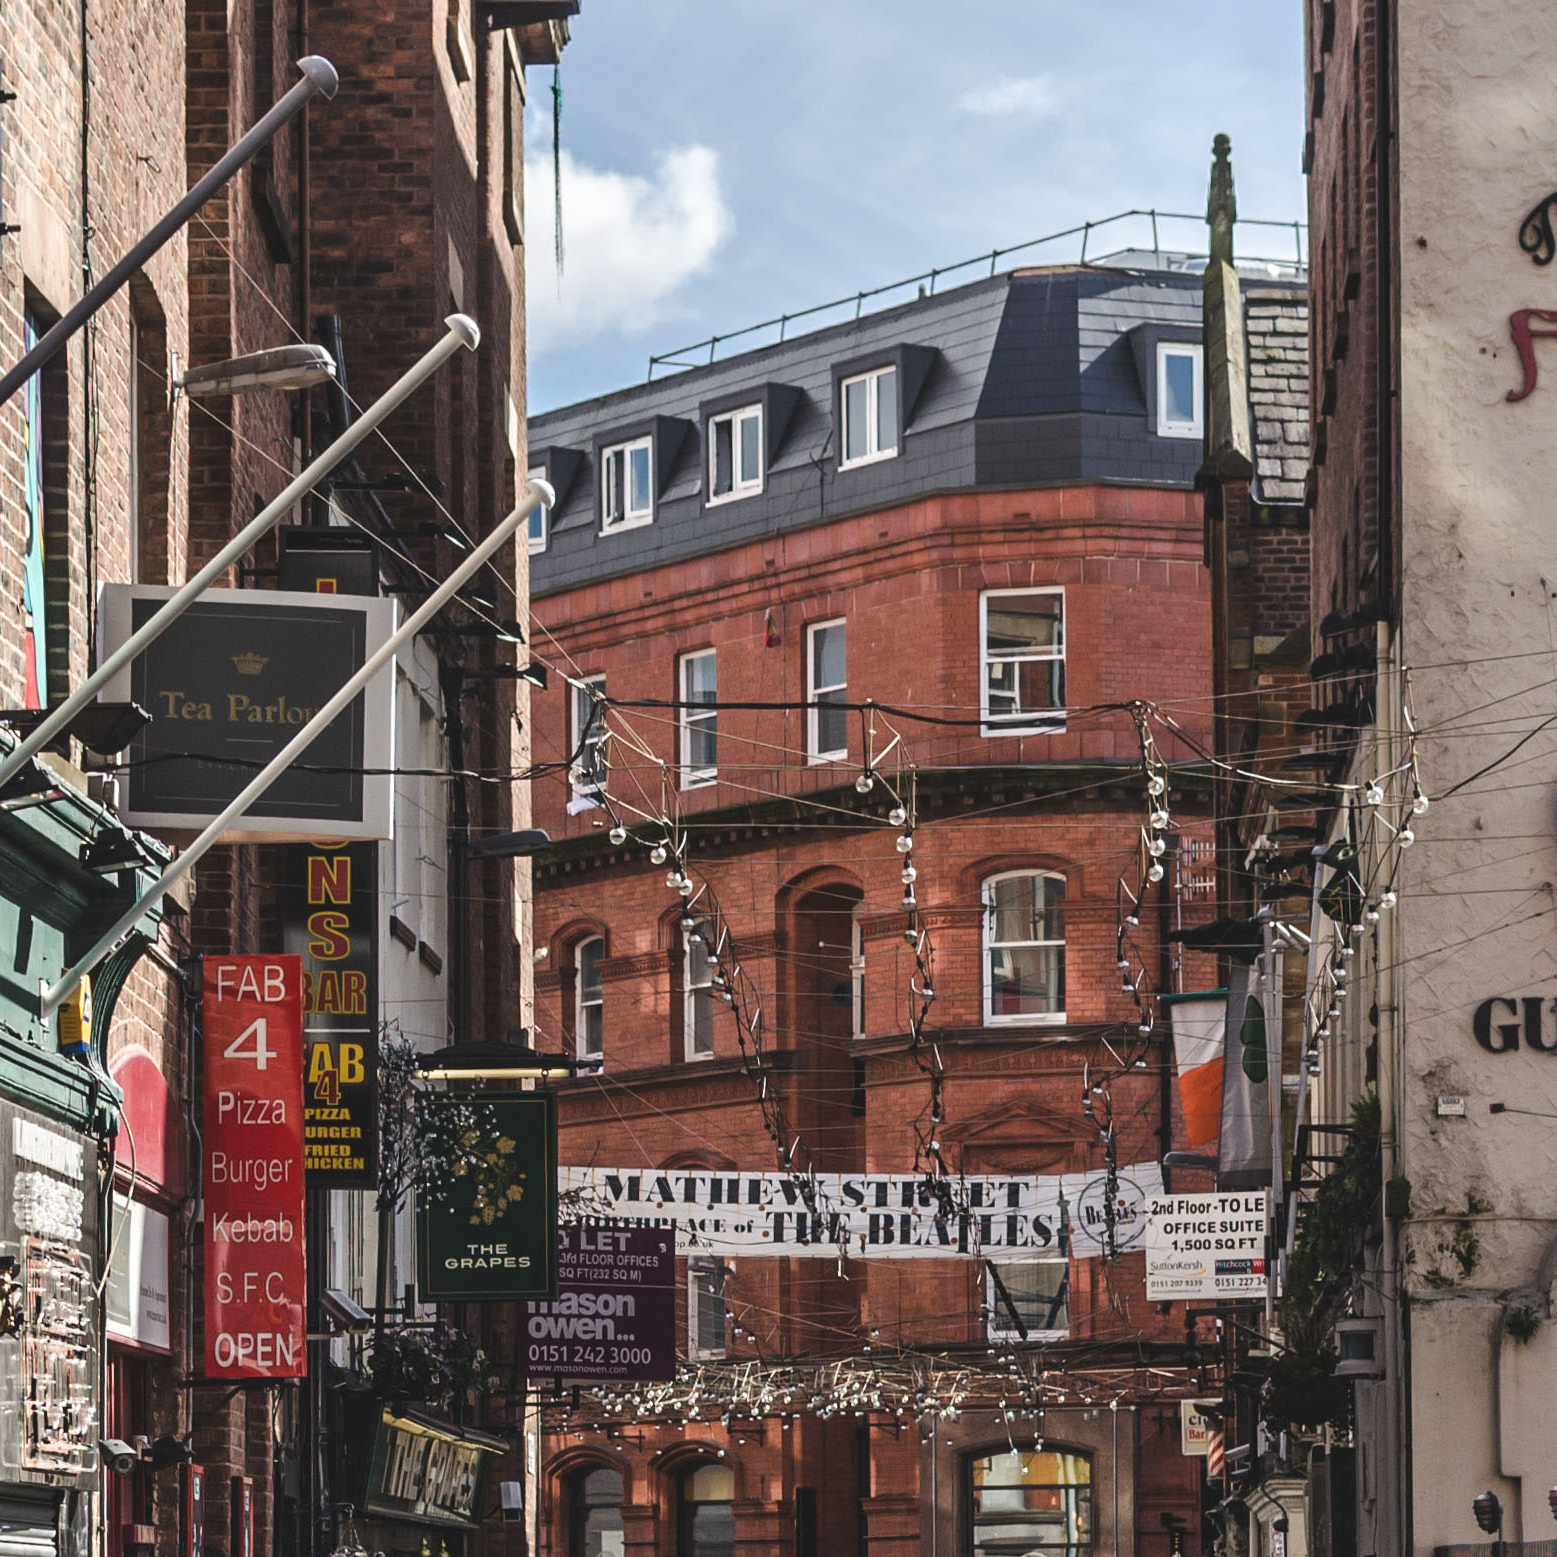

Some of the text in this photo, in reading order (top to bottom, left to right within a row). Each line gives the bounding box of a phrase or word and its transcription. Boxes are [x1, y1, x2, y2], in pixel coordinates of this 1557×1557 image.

[160, 691, 212, 721] Tea
[218, 966, 287, 1002] FAB
[223, 1018, 278, 1071] 4
[305, 1043, 365, 1084] AB
[315, 1070, 342, 1105] 4
[218, 1092, 287, 1125] Pizza
[304, 1107, 351, 1121] PIZZA
[304, 1127, 362, 1139] URGER
[304, 1145, 351, 1158] FRIED
[211, 1153, 293, 1190] Burger
[304, 1158, 364, 1170] HICKEN
[603, 1174, 825, 1207] MATHEW
[1151, 1200, 1174, 1216] 2nd
[1178, 1199, 1212, 1214] Floor
[1218, 1198, 1241, 1213] TO
[1244, 1197, 1265, 1212] LE
[212, 1213, 294, 1244] Kebab
[734, 1219, 754, 1234] of
[765, 1211, 851, 1245] THE
[867, 1212, 1053, 1254] BEATLES
[1163, 1220, 1264, 1235] OFFICE SUITE
[467, 1244, 509, 1256] THE
[579, 1231, 632, 1252] LET
[1172, 1237, 1258, 1253] 1,500 SQ FT
[444, 1256, 532, 1270] GRAPES
[579, 1254, 615, 1266] FLOOR
[617, 1255, 660, 1268] OFFICES
[558, 1267, 575, 1279] SQ
[612, 1269, 628, 1281] SQ
[1214, 1277, 1267, 1287] 0151 227 34
[528, 1291, 636, 1317] mason
[214, 1332, 294, 1368] OPEN
[528, 1344, 652, 1365] 0151 242 3000
[528, 1363, 628, 1375] www.masonowen.com
